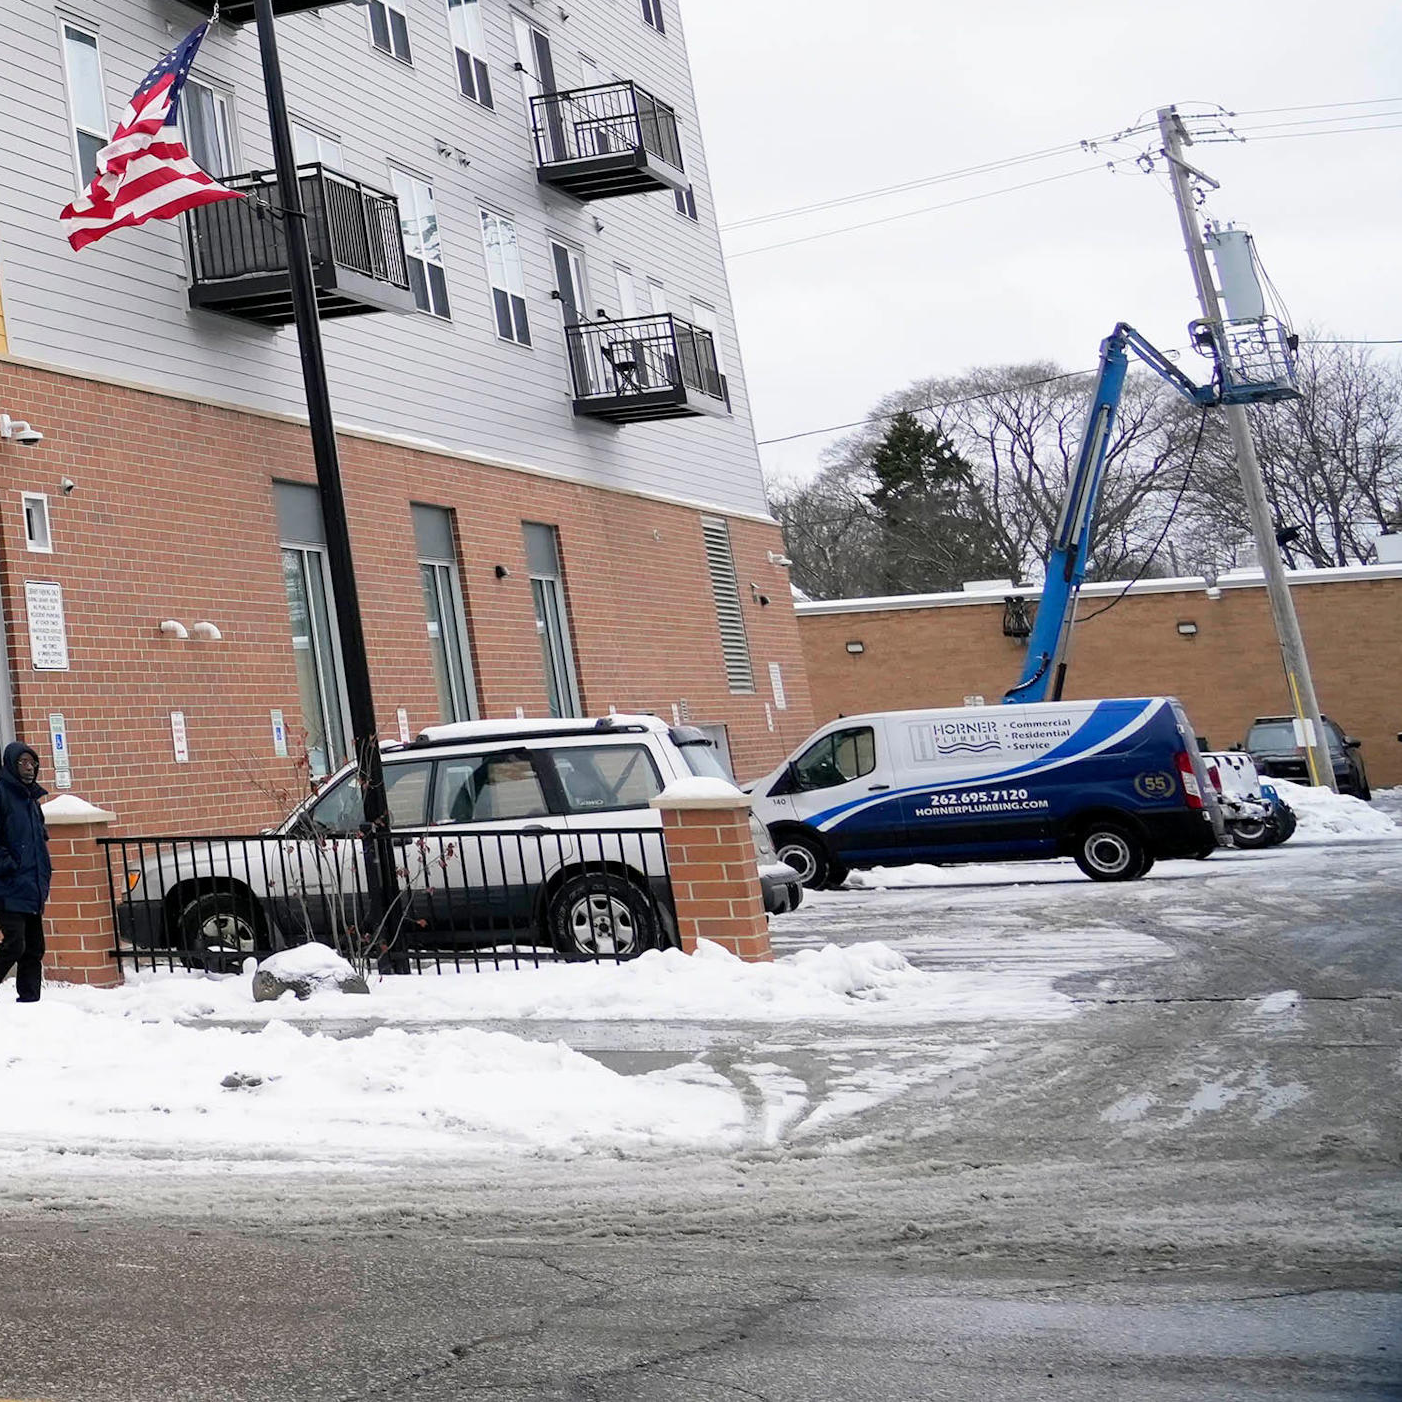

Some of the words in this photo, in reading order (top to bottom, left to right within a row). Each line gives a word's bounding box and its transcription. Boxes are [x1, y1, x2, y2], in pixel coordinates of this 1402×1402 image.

[933, 721, 997, 735] HORNER
[1009, 718, 1071, 729] Commercial
[935, 734, 1000, 743] PLUMBING
[1011, 729, 1070, 740] Residential
[1013, 741, 1051, 750] Service
[1145, 777, 1166, 790] 55
[931, 789, 1028, 805] 262.695.7120
[915, 800, 1049, 816] HORNERPLUMBING.COM
